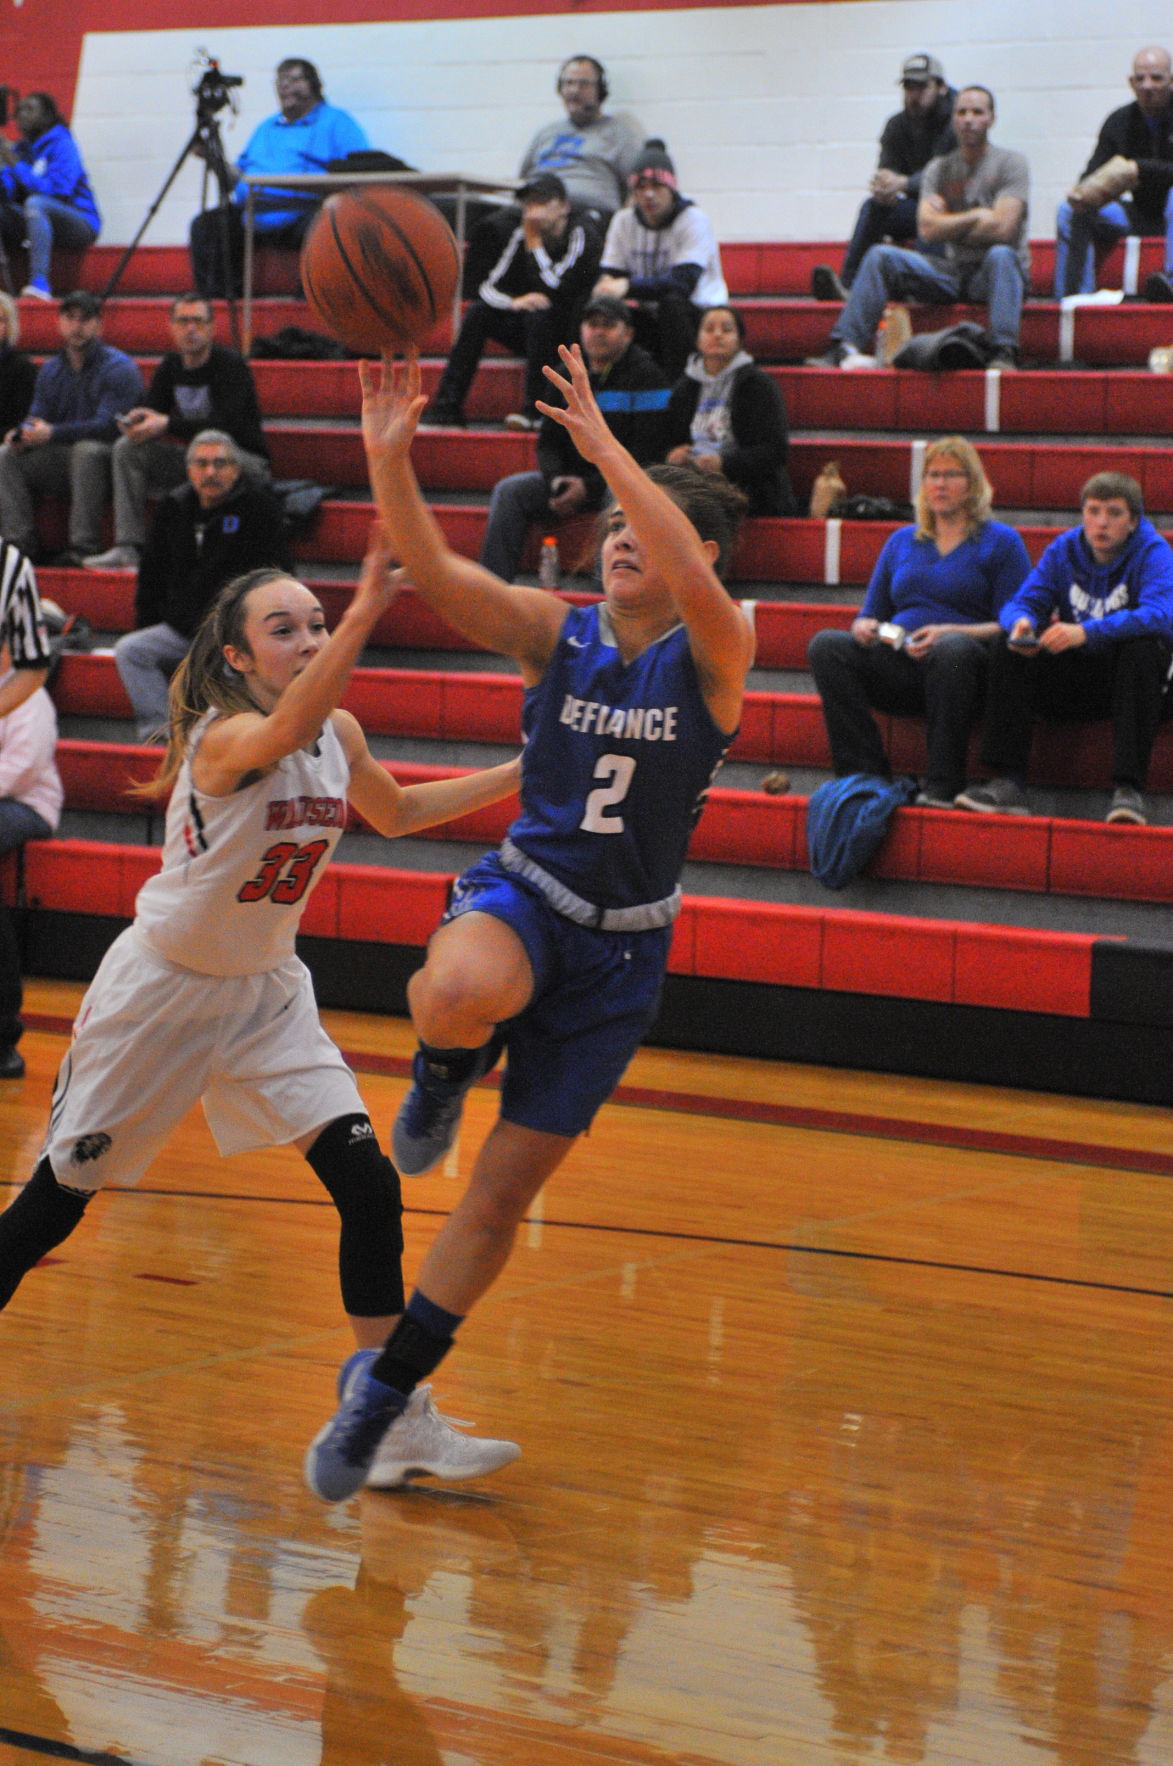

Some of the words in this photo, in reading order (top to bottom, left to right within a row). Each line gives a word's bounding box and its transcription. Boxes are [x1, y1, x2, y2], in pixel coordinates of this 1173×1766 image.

[559, 694, 679, 741] DEFIANCE
[579, 753, 637, 834] 2
[236, 838, 329, 905] 33
